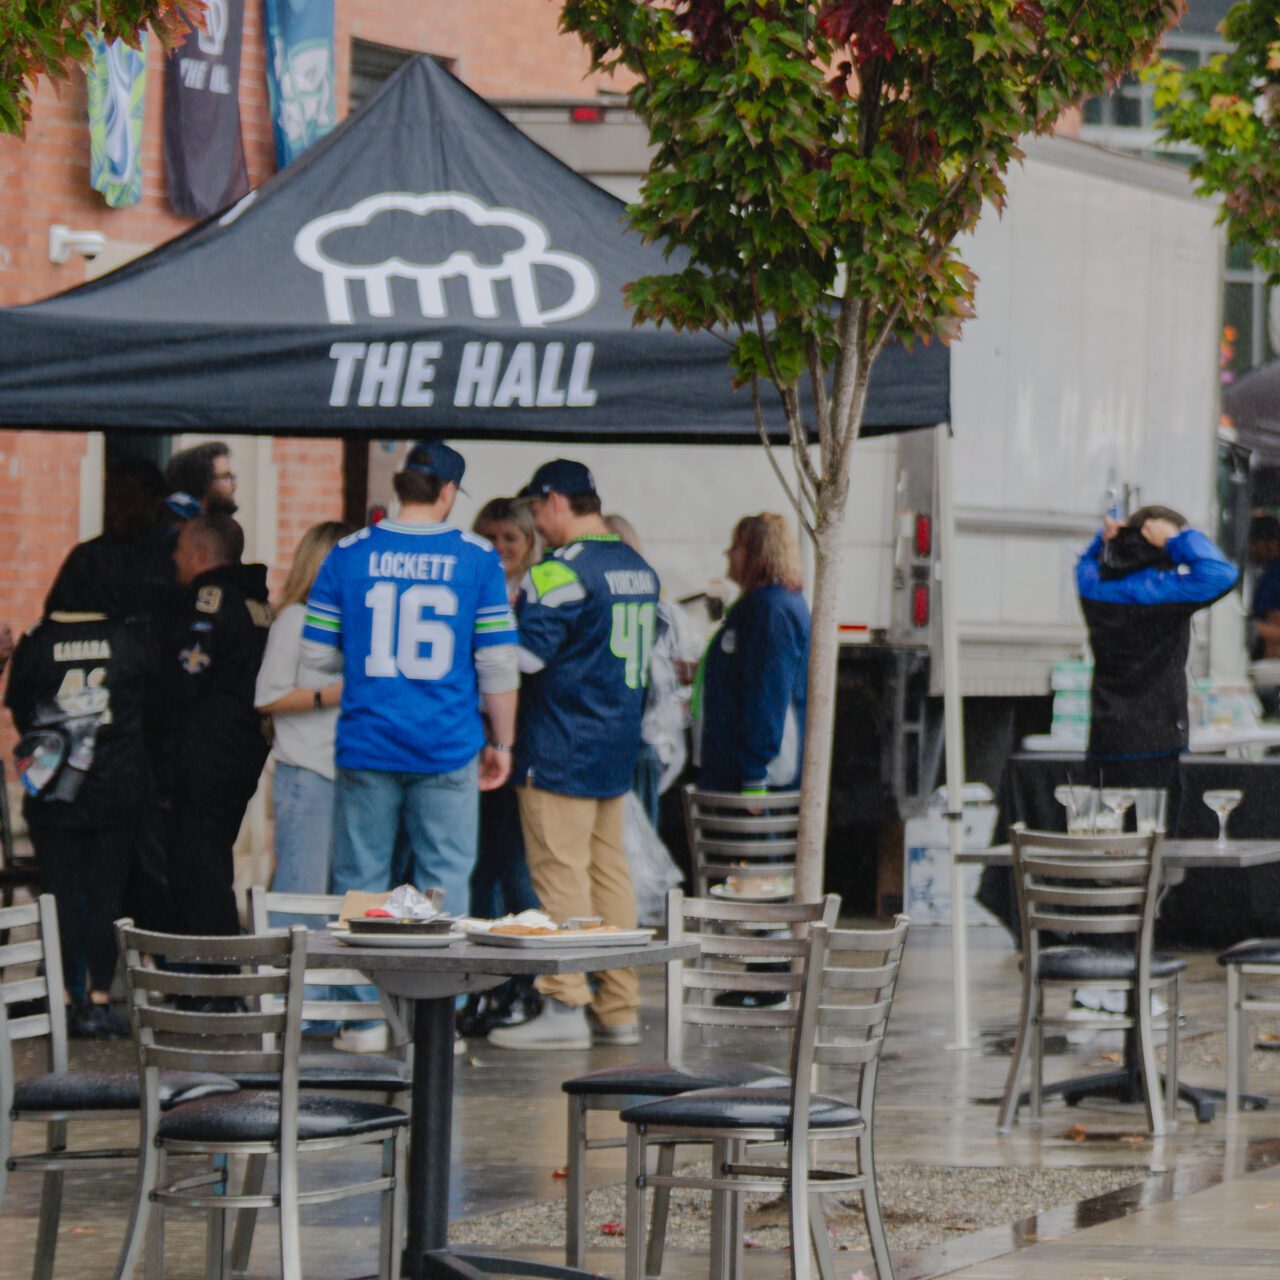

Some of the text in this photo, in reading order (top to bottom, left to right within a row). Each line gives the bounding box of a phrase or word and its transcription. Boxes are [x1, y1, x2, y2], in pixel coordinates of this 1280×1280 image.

[328, 341, 598, 407] THE HALL
[368, 551, 457, 581] LOCKETT
[195, 585, 222, 614] 9
[364, 581, 459, 680] 16
[610, 601, 658, 689] 41
